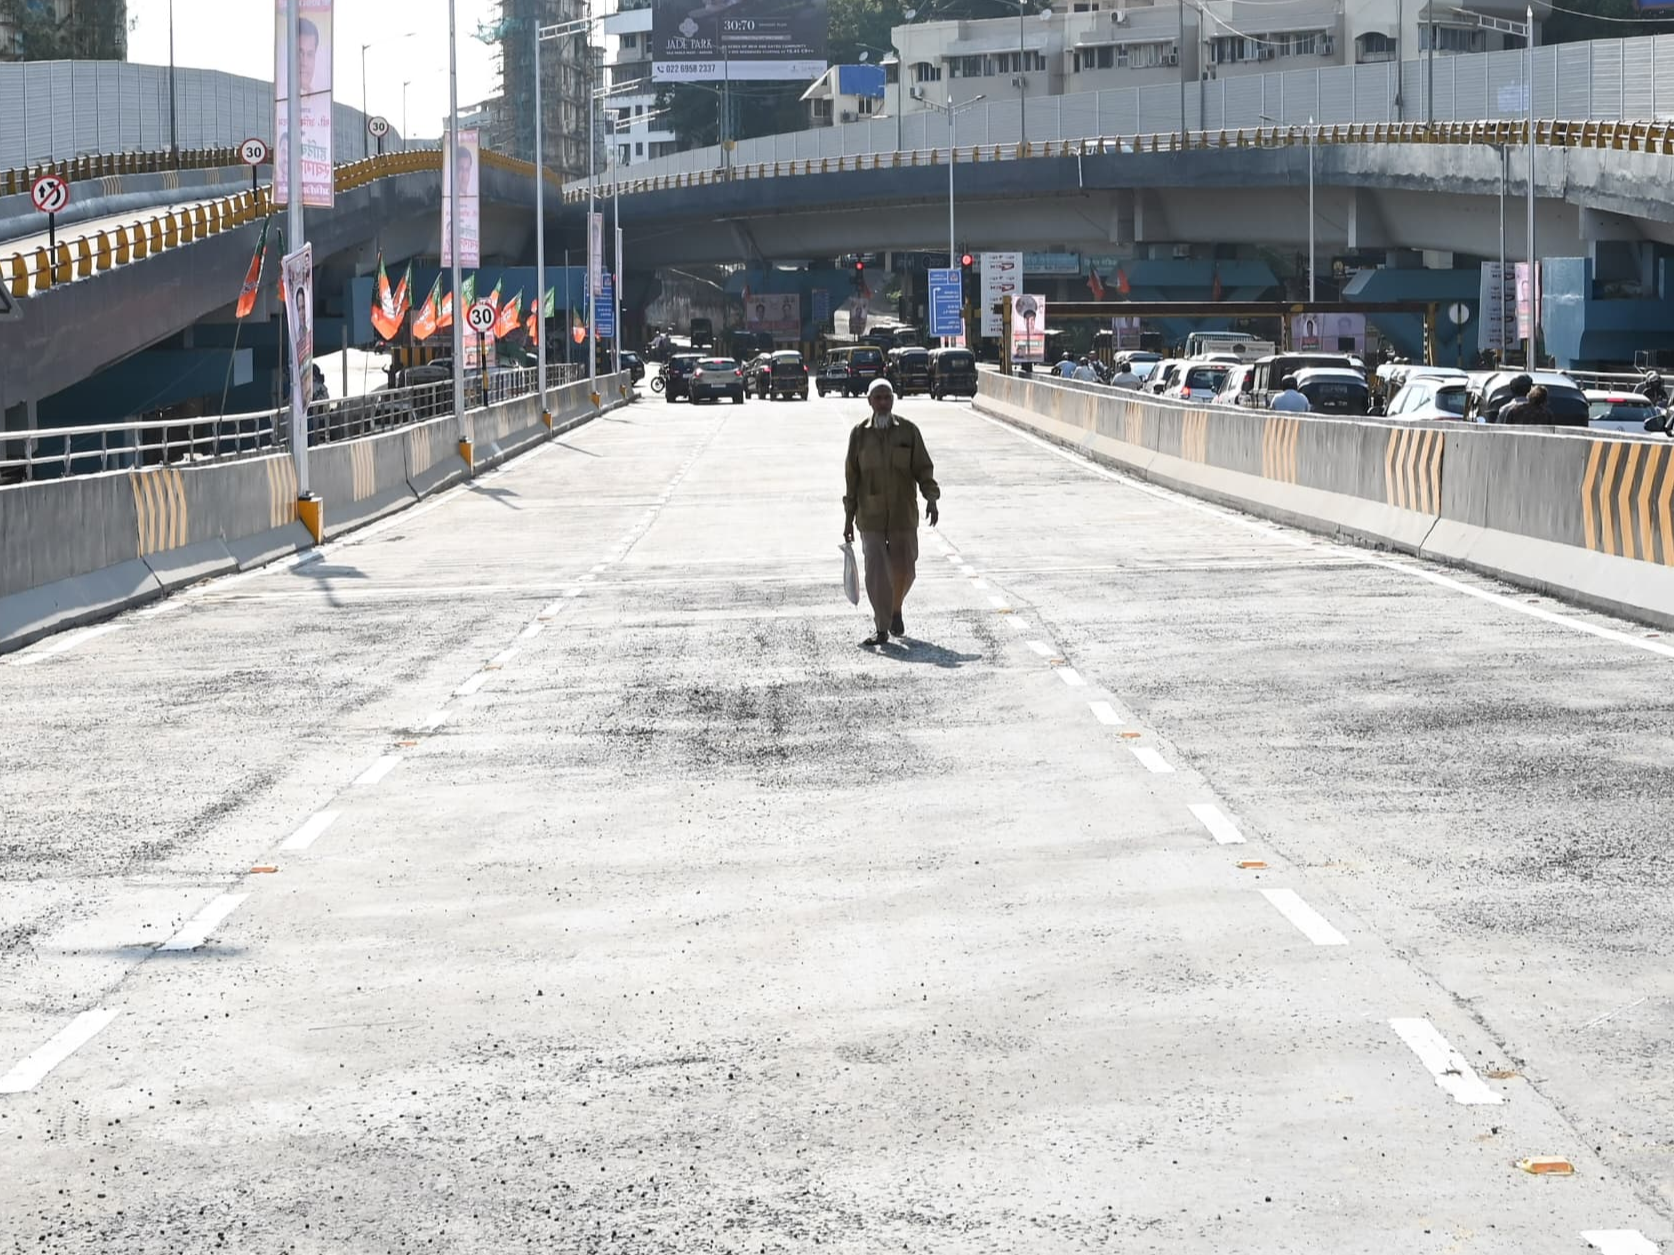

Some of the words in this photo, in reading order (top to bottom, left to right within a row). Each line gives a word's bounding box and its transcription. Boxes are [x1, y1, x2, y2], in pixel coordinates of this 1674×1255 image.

[724, 20, 755, 31] 30:70
[666, 38, 687, 49] JADE
[691, 38, 713, 49] PARK
[666, 64, 679, 73] 022
[372, 122, 385, 131] 30
[246, 147, 262, 159] 30
[472, 309, 492, 325] 30
